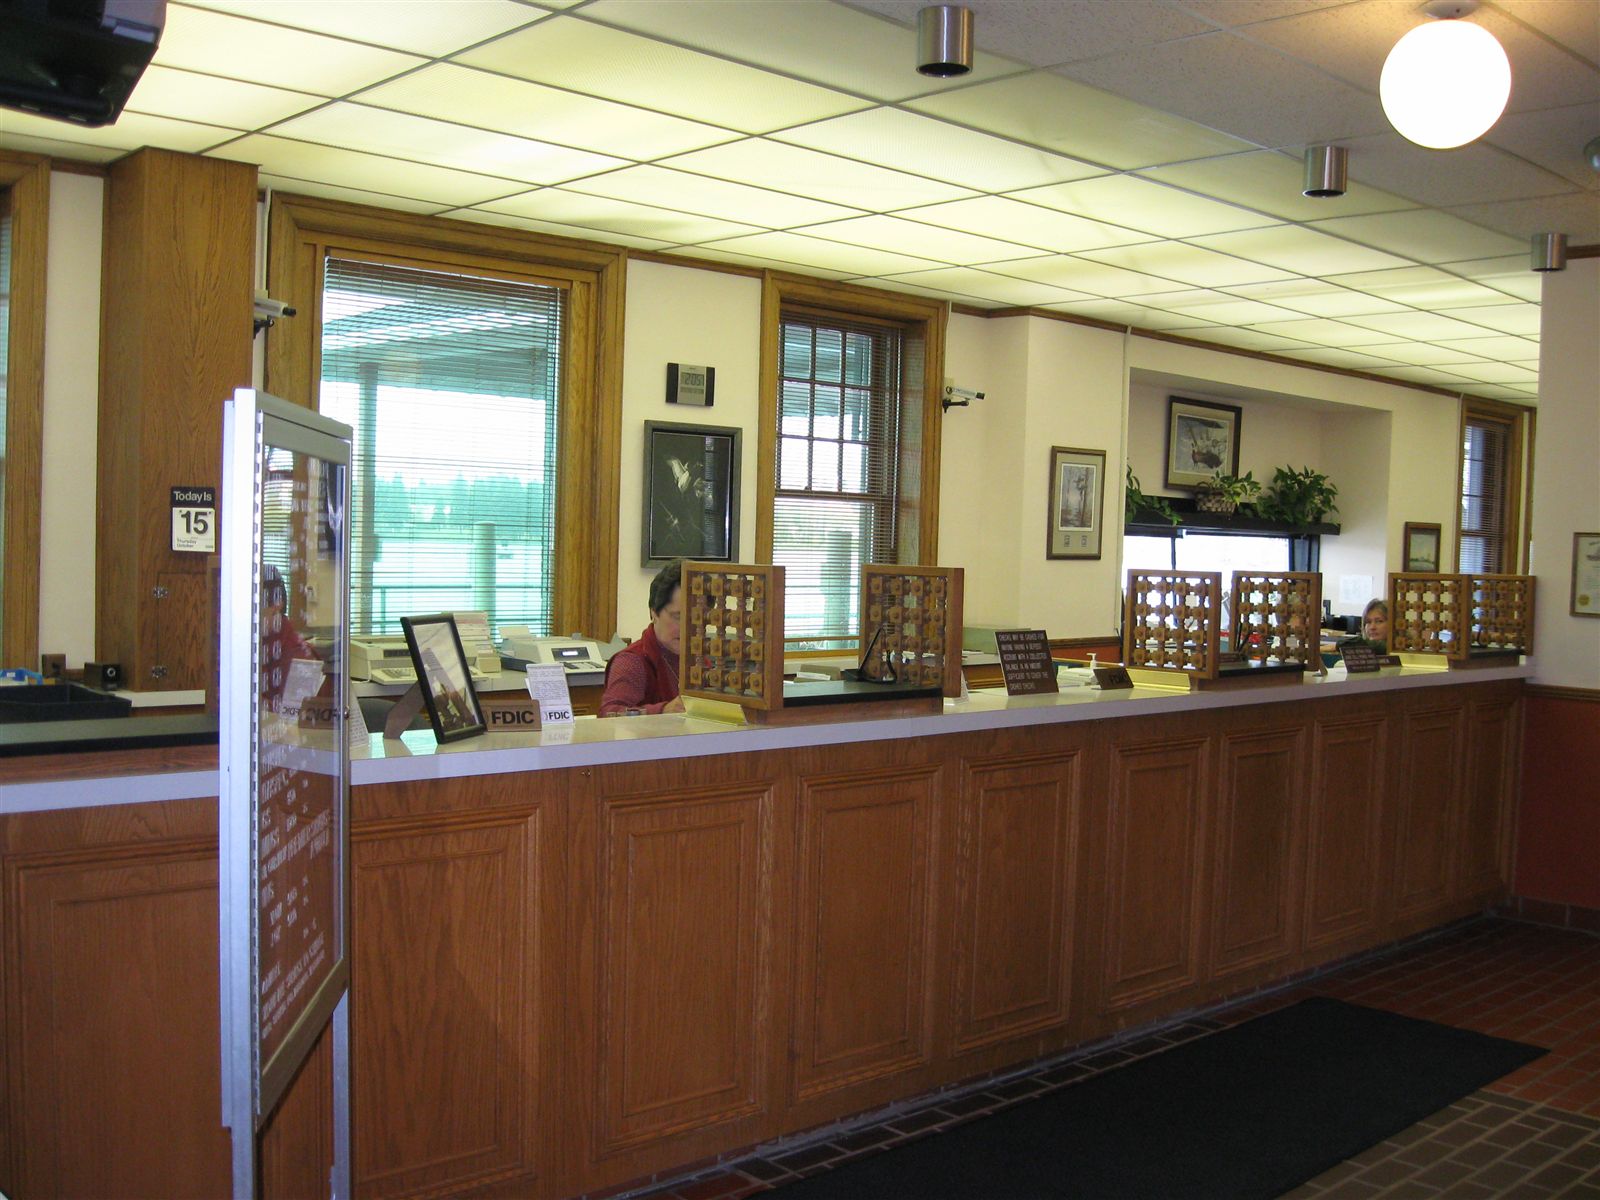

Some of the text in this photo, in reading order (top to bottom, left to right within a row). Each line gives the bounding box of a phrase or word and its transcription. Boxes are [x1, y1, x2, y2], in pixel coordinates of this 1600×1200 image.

[173, 491, 212, 503] Today Is
[180, 510, 209, 535] 15
[491, 710, 534, 724] FDIC
[548, 711, 570, 720] FDIC
